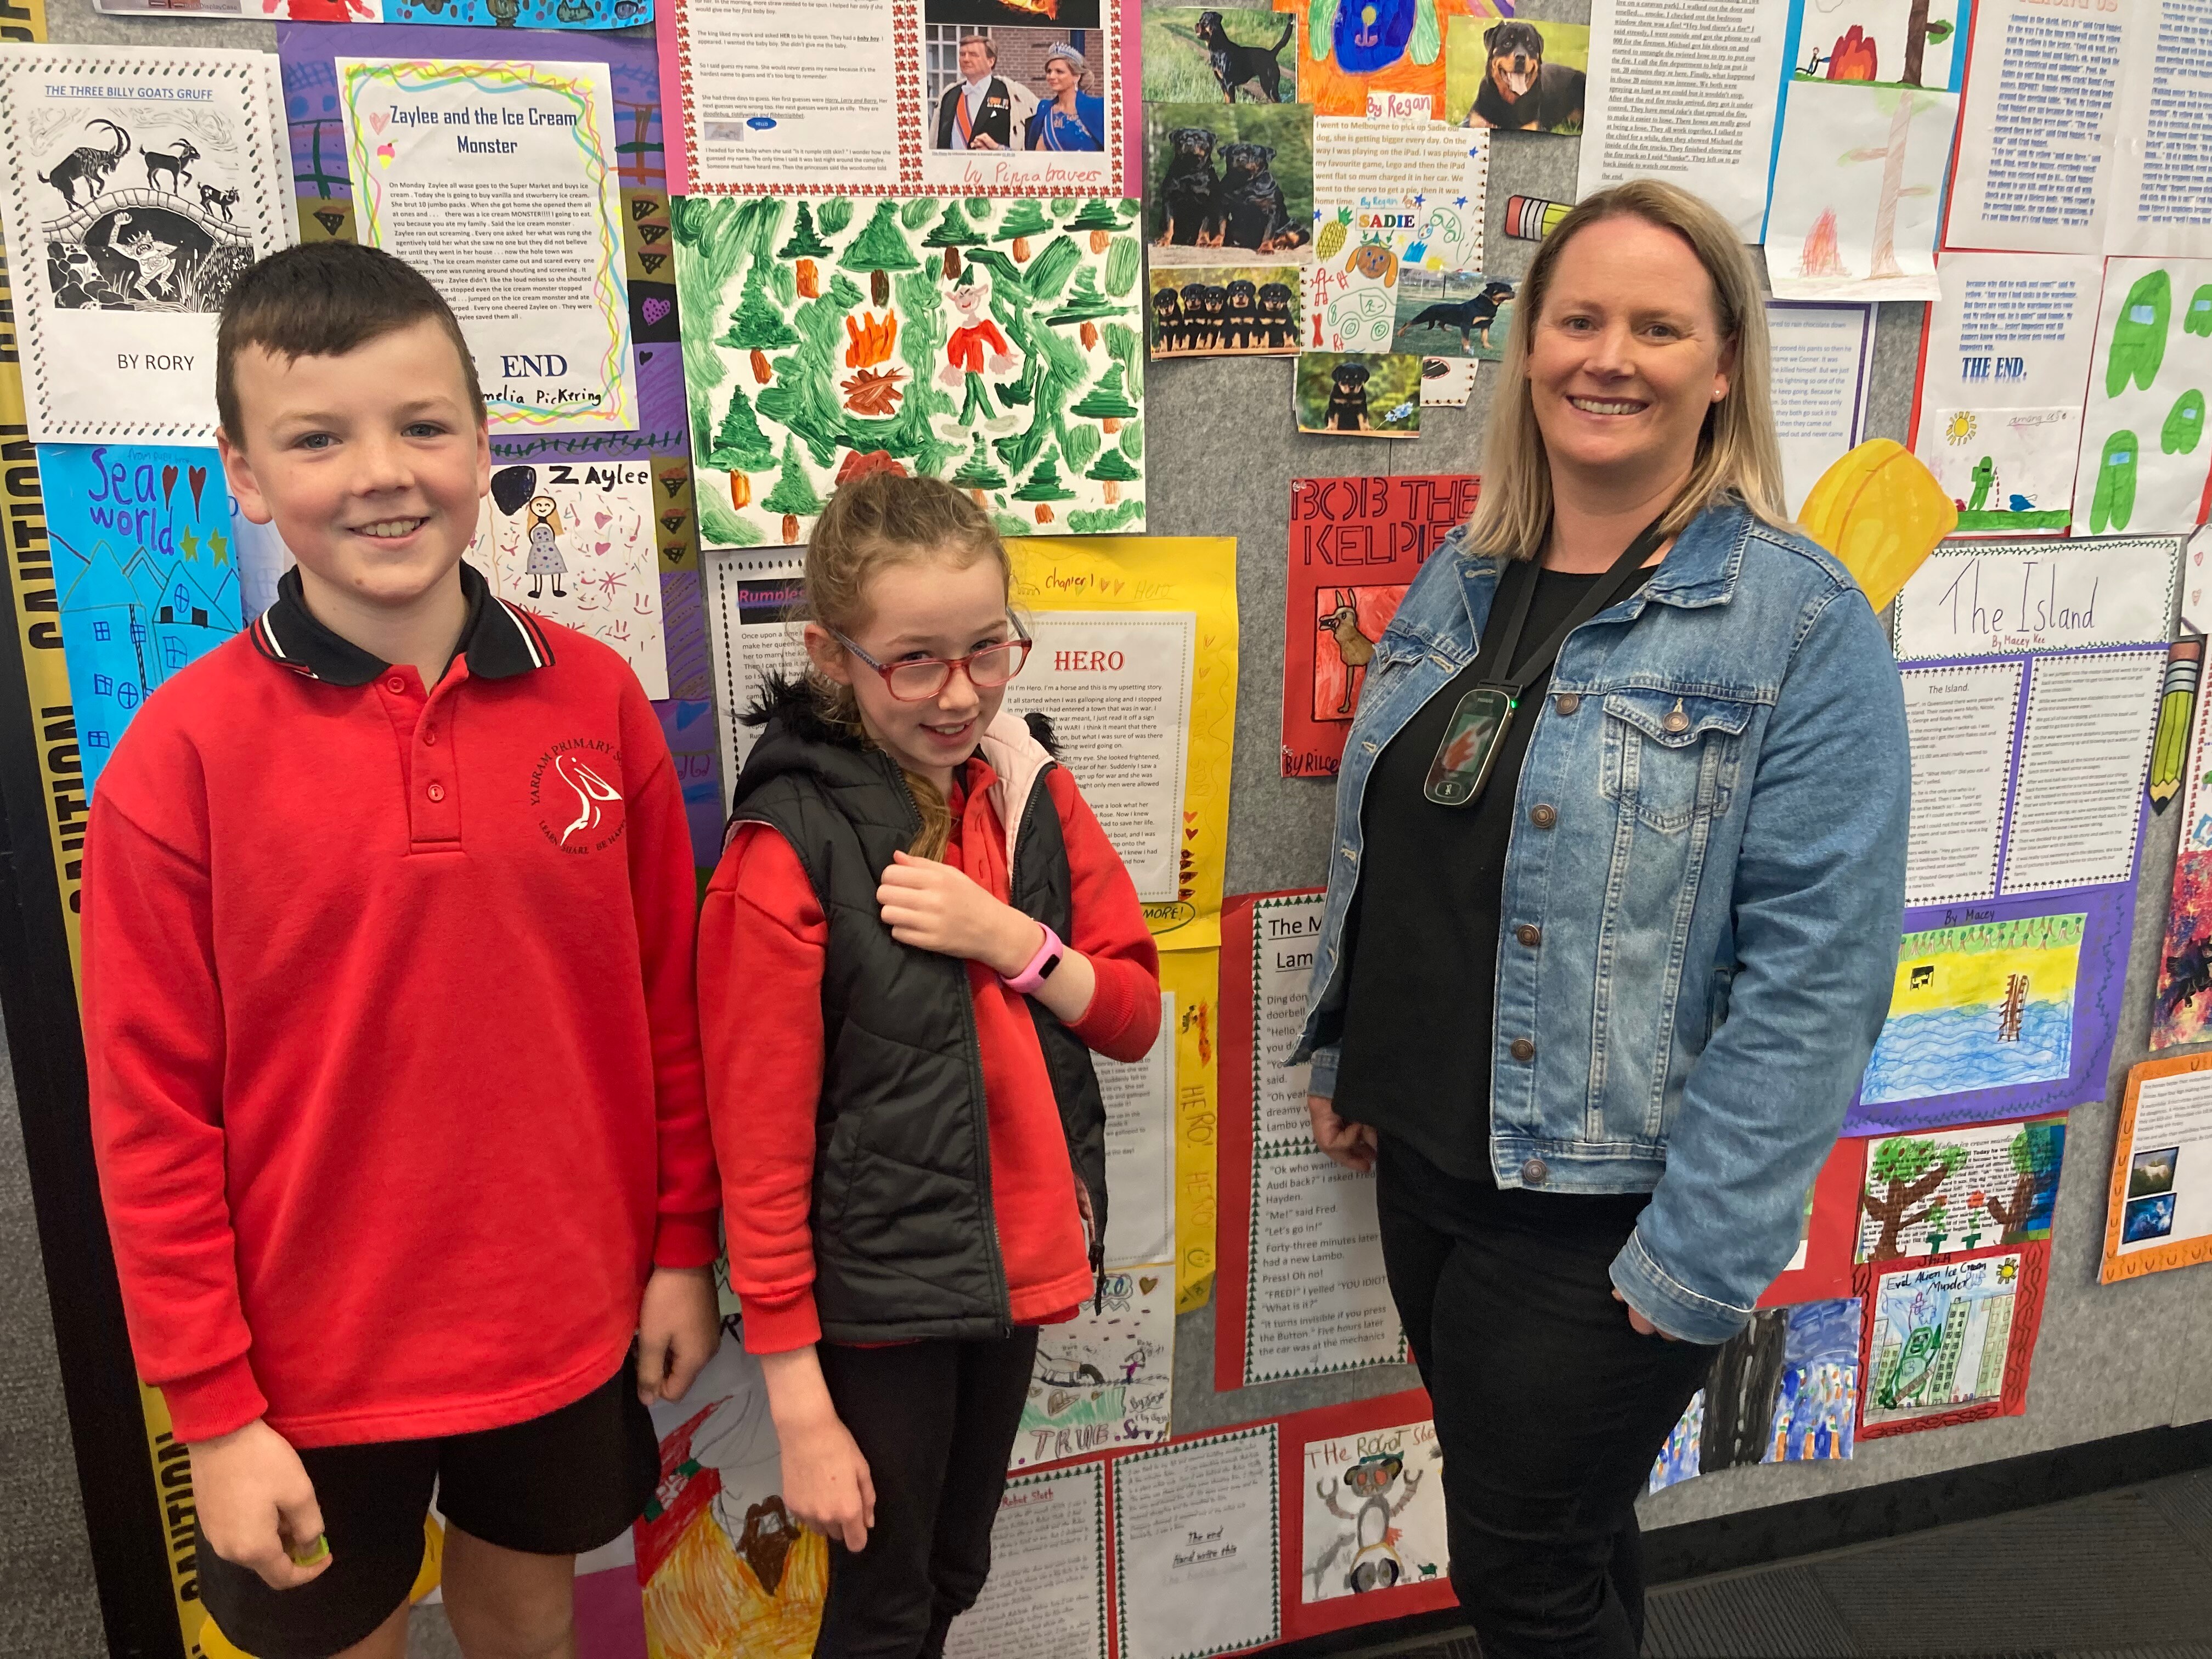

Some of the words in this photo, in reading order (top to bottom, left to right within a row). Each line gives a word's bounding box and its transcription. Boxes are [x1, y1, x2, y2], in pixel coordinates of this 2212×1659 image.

[45, 85, 65, 97] THE
[70, 86, 104, 98] THREE
[107, 87, 134, 99] BILLY
[138, 88, 173, 100] GOATS
[177, 88, 213, 101] GRUFF
[1367, 97, 1382, 117] By
[1388, 94, 1430, 118] Regan
[390, 105, 439, 128] Zaylee
[443, 106, 470, 125] and
[474, 106, 498, 125] the
[502, 107, 524, 126] Ice
[528, 107, 578, 126] Cream
[457, 135, 518, 154] Monster
[1316, 133, 1333, 143] dog,
[1333, 133, 1346, 142] she
[1355, 135, 1380, 144] getting
[1381, 135, 1404, 145] bigger
[1405, 137, 1425, 145] every
[1426, 136, 1441, 146] day.
[1443, 137, 1454, 145] On
[1454, 137, 1467, 145] the
[400, 182, 425, 190] Monday
[510, 182, 528, 190] Super
[564, 182, 579, 190] buys
[1358, 214, 1415, 228] SADIE
[117, 354, 139, 369] BY
[145, 354, 194, 371] RORY
[500, 354, 568, 378] END
[1962, 357, 1991, 378] THE
[1994, 358, 2027, 378] END.
[483, 384, 525, 403] melia
[1778, 387, 1792, 396] keep
[88, 447, 157, 505] Sea
[1290, 477, 1388, 521] BOB
[1401, 478, 1481, 520] THE
[90, 506, 174, 556] world
[1939, 558, 2004, 634] The
[2017, 562, 2098, 632] Island
[1991, 635, 2002, 648] By
[2004, 634, 2030, 647] Macey
[1054, 651, 1124, 672] HERO
[1928, 685, 1943, 694] The
[1945, 682, 1970, 693] Island.
[531, 752, 552, 806] YARRAM
[551, 738, 614, 755] PRIMARY
[1285, 754, 1303, 777] BY
[1143, 906, 1184, 921] MORE!
[1944, 910, 1957, 926] By
[1965, 908, 1995, 923] Macey
[1268, 918, 1302, 936] The
[1277, 952, 1313, 969] Lam
[1266, 1181, 1288, 1190] Audi
[1328, 1172, 1353, 1183] asked
[1262, 1256, 1280, 1267] had
[1290, 1256, 1310, 1265] new
[1312, 1251, 1345, 1262] Lambo.
[1188, 1531, 1204, 1544] The
[1206, 1526, 1224, 1543] end
